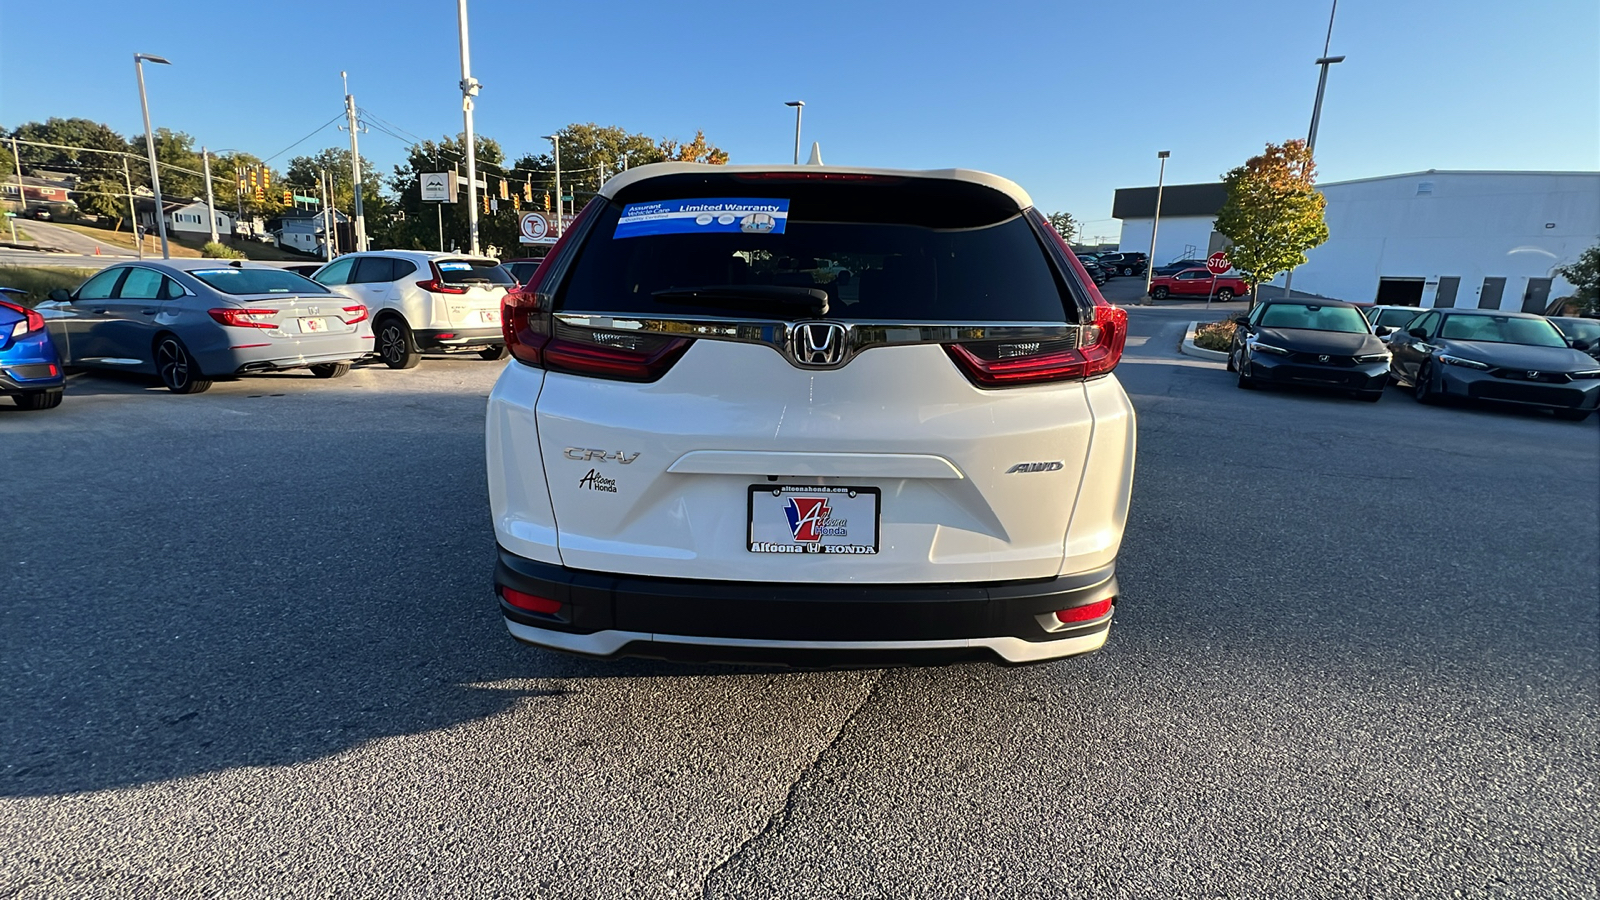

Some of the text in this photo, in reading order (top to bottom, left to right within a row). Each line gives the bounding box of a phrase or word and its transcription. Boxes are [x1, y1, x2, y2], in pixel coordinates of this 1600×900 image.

[627, 209, 652, 217] Vehicle
[628, 203, 662, 212] Assurant
[679, 203, 780, 213] Limited Warranty
[1208, 258, 1231, 269] STOP
[563, 446, 641, 465] CR-V
[1004, 461, 1064, 475] AWD
[579, 468, 616, 490] Altoona
[594, 484, 618, 493] Honda
[794, 501, 848, 537] Altoona
[815, 525, 848, 537] Honda
[751, 542, 877, 555] Altoona HONDA
